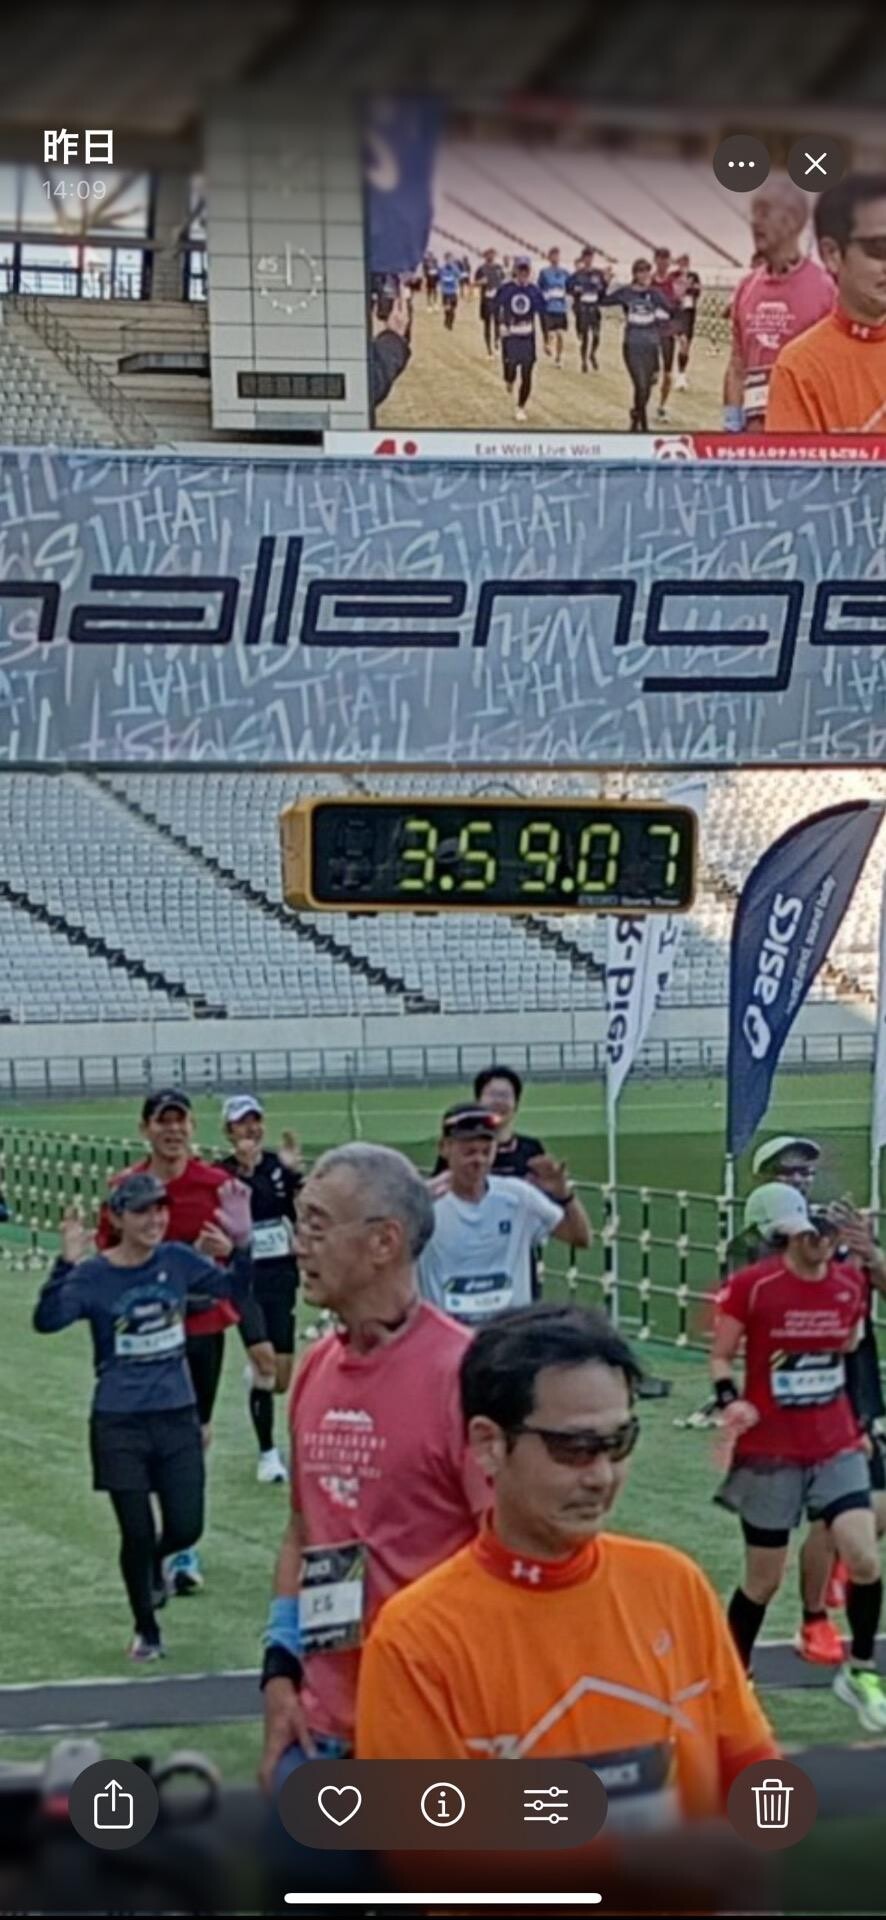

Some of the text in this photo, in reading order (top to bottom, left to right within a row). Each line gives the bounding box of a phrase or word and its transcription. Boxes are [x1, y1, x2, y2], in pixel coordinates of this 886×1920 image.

[474, 443, 497, 456] Eat
[94, 485, 238, 545] THAT
[450, 492, 591, 548] THAT
[273, 669, 418, 727] THAT
